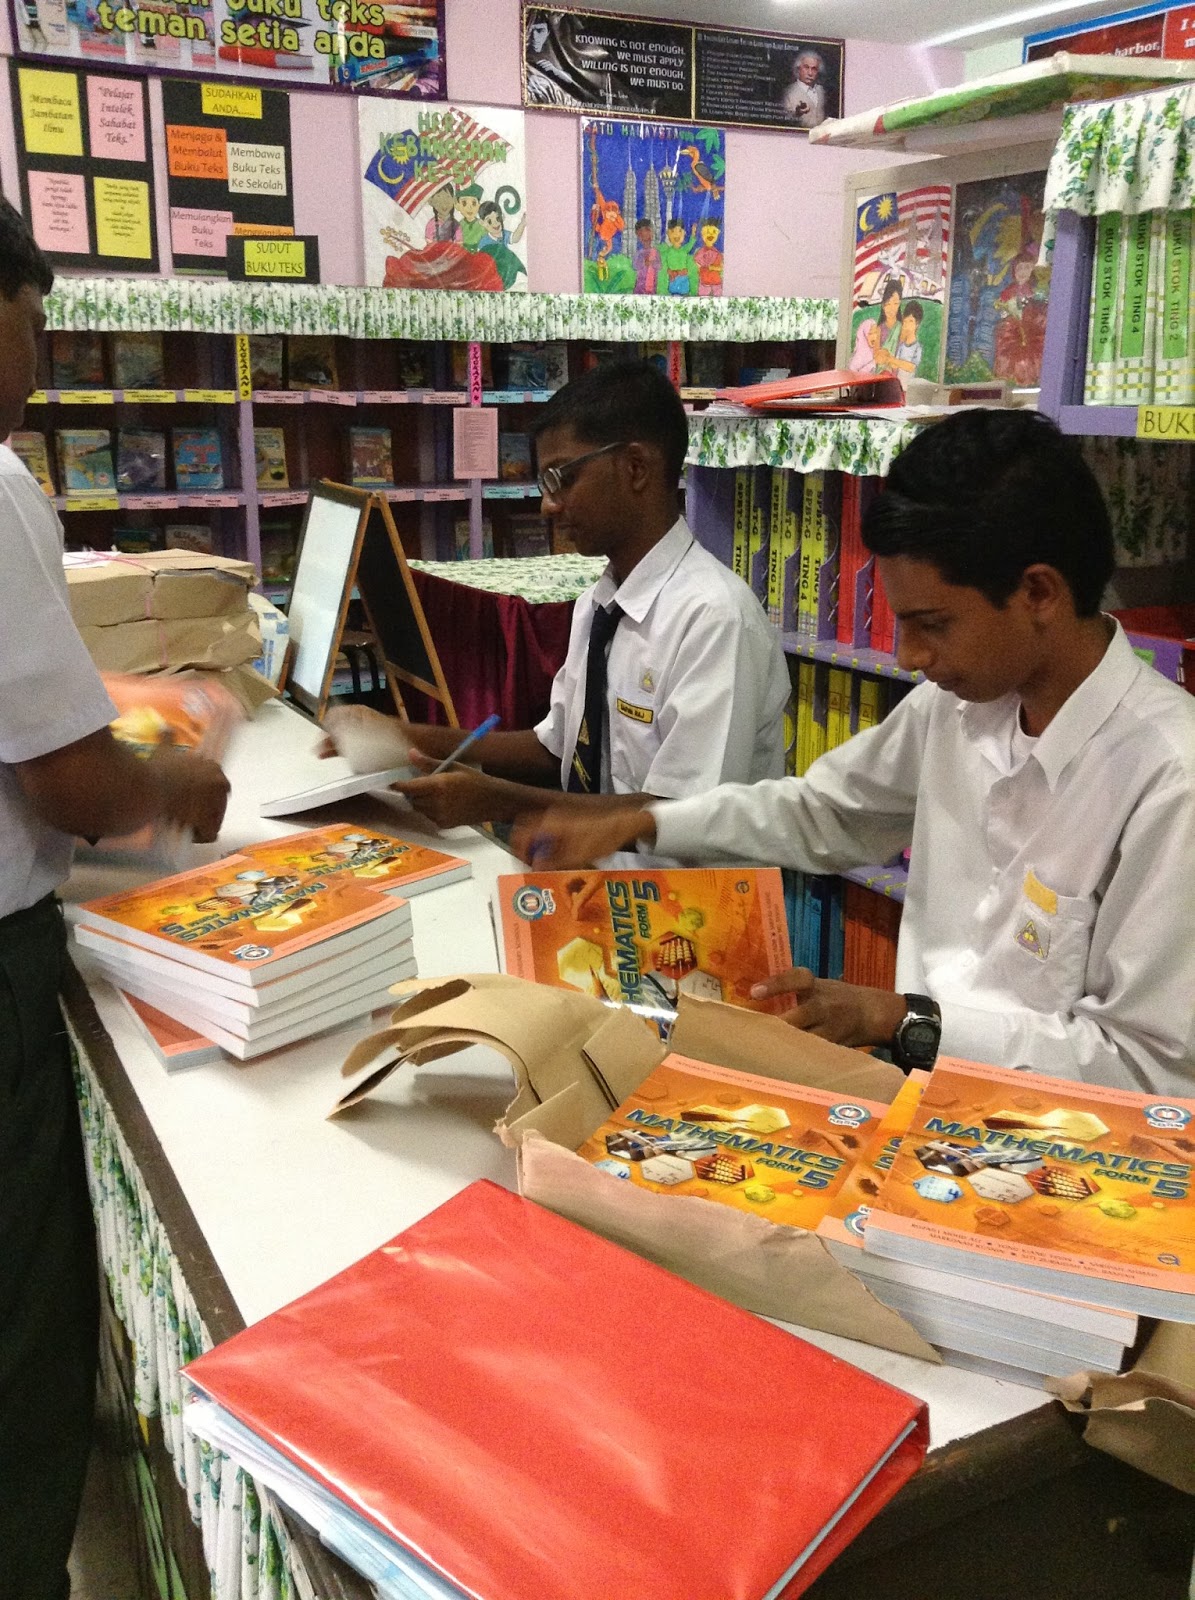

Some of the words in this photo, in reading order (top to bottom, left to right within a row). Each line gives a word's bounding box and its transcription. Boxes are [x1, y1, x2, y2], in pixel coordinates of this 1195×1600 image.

[317, 0, 386, 27] teks
[97, 2, 206, 40] teman
[220, 19, 300, 51] setia
[314, 26, 386, 59] anda
[575, 34, 618, 47] KNOWING
[620, 40, 628, 49] IS
[629, 41, 646, 51] NOT
[649, 43, 686, 55] ENOUGH.
[617, 51, 631, 60] WE
[633, 54, 657, 64] MUST
[660, 56, 686, 67] APPLY.
[582, 60, 618, 71] WILLING
[620, 63, 628, 73] IS
[630, 65, 647, 75] NOT
[649, 67, 686, 80] ENOUGH.
[205, 87, 258, 101] SUDAHKAH
[630, 77, 645, 87] WE
[647, 79, 670, 89] MUST
[672, 82, 686, 91] DO.
[99, 118, 136, 129] Sahabat
[171, 129, 213, 144] Menjaga
[173, 145, 223, 158] Membalut
[230, 147, 281, 159] Membawa
[175, 161, 199, 173] Buku
[201, 162, 224, 174] Teks
[232, 162, 257, 173] Buku
[260, 164, 281, 175] Teks
[231, 178, 245, 188] Ke
[246, 178, 283, 191] Sekolah
[172, 210, 232, 225] Memulangkan
[191, 225, 214, 236] Buku
[1172, 219, 1182, 256] BUKU
[193, 239, 214, 248] Teks
[256, 242, 291, 254] SUDUT
[1105, 228, 1114, 263] BUKU
[246, 261, 277, 273] BUKU
[278, 262, 304, 274] TEKS
[1134, 253, 1144, 288] STOK
[1171, 259, 1181, 294] STOK
[1103, 266, 1112, 300] STOK
[1131, 294, 1141, 323] TING
[1170, 302, 1179, 330] TING
[1100, 306, 1109, 335] TING
[770, 550, 778, 583] TING
[801, 555, 810, 590] TING
[631, 879, 660, 902] 5
[179, 881, 328, 943] MATHEMATICS
[638, 902, 650, 940] FORM
[604, 879, 642, 1004] HEMATICS
[625, 1108, 847, 1172] MATHEMATICS
[923, 1117, 1193, 1179] MATHEMATICS
[755, 1156, 804, 1173] FORM
[795, 1169, 836, 1190] 5
[1093, 1167, 1150, 1184] FORM
[1151, 1178, 1192, 1199] 5
